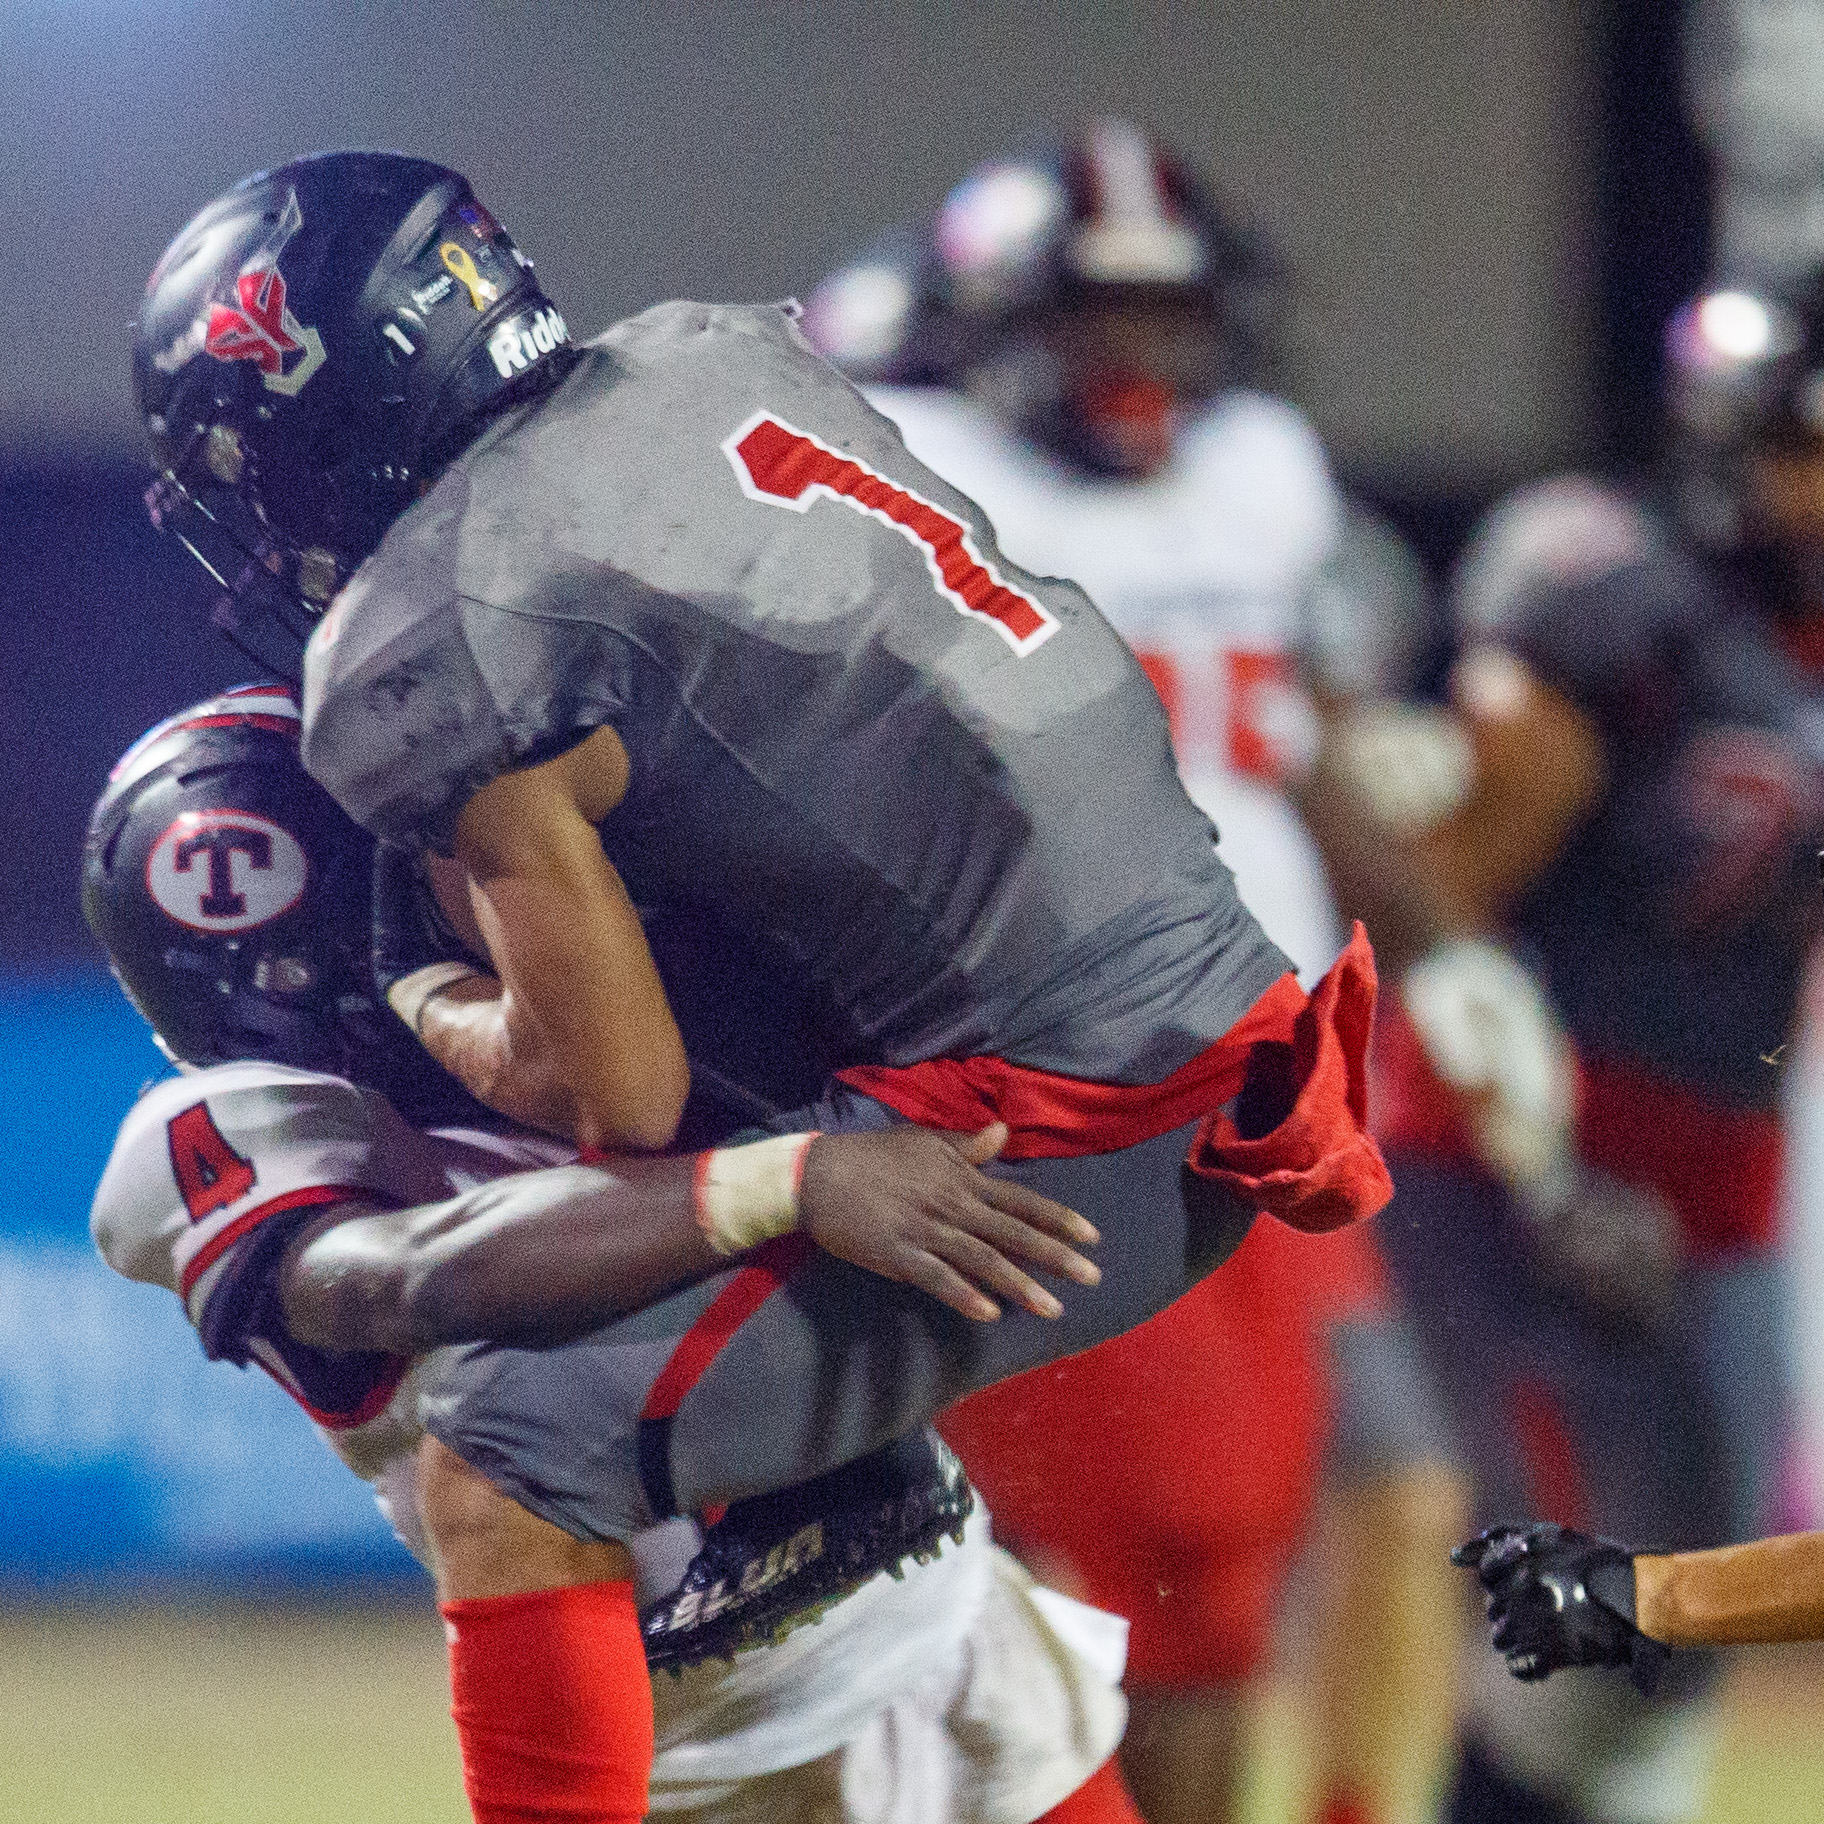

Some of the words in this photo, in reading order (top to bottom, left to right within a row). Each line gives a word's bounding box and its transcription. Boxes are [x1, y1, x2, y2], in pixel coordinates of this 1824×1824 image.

[488, 306, 573, 379] Ridd
[721, 408, 1061, 658] 1
[175, 823, 272, 919] T
[165, 1098, 258, 1226] 4
